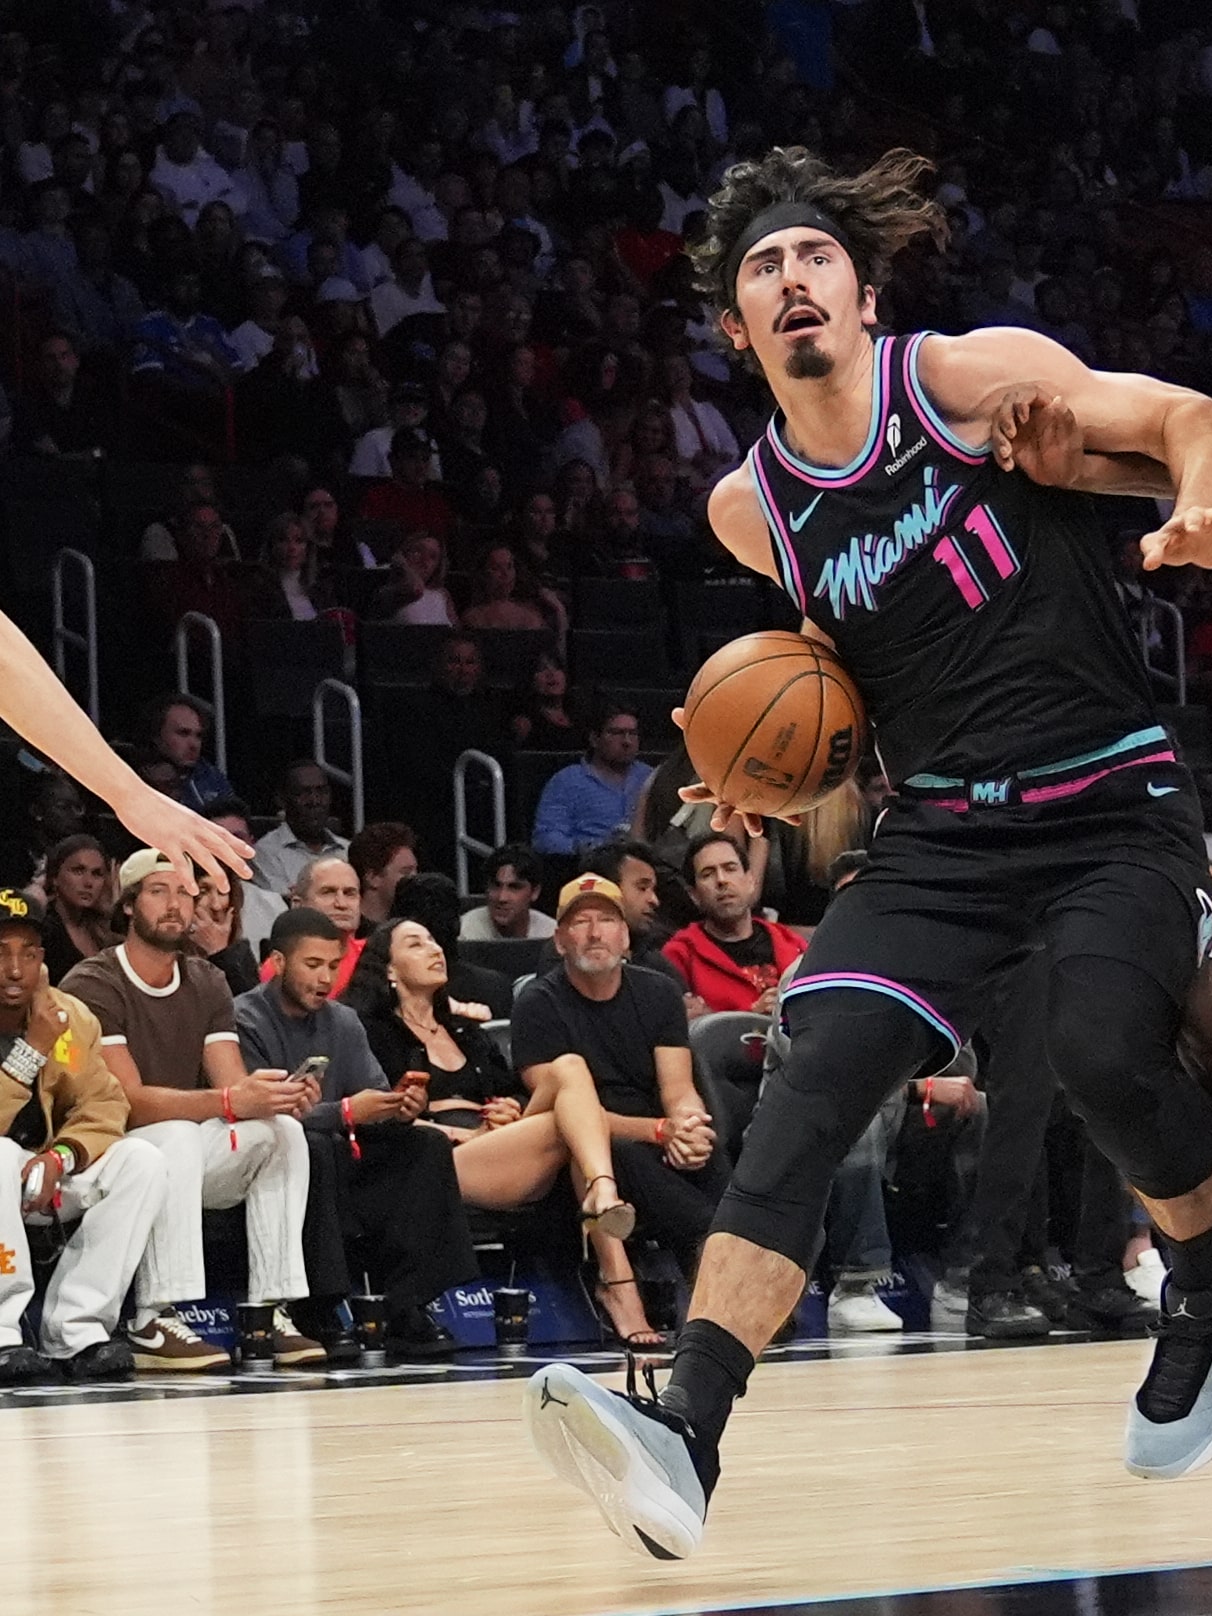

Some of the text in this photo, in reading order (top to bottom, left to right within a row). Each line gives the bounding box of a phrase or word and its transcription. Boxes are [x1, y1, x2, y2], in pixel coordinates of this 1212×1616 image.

[884, 436, 928, 476] Robinhood
[813, 466, 963, 621] Miami
[932, 503, 1021, 613] 11
